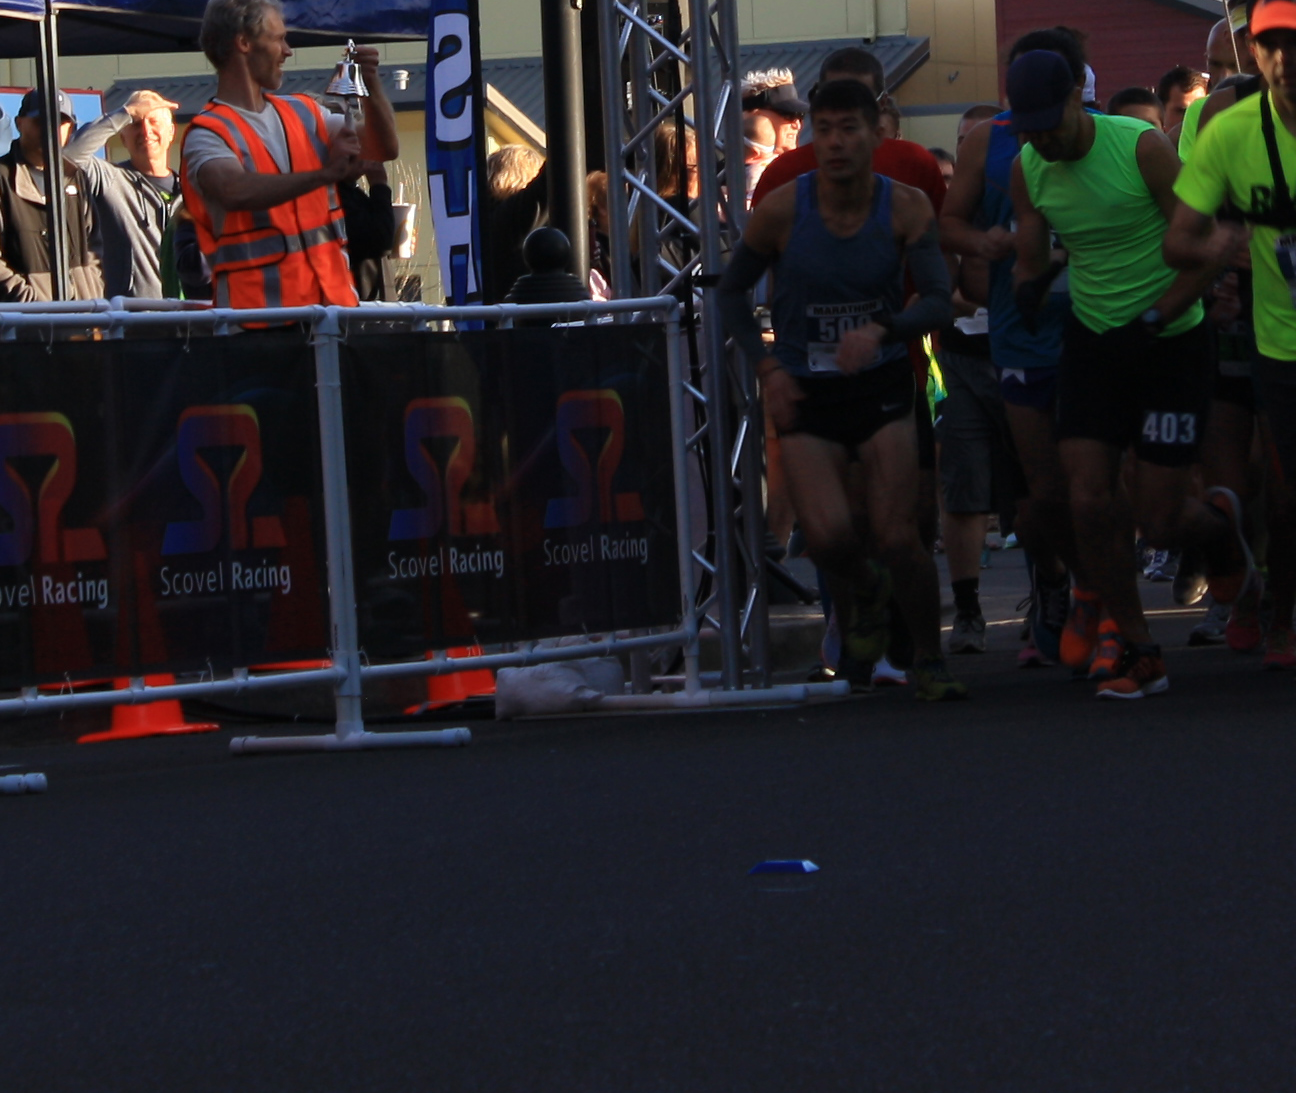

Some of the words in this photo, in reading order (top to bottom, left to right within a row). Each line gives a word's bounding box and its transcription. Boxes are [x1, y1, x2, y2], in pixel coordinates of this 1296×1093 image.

[813, 301, 878, 315] MARATHON
[1142, 410, 1197, 444] 403
[387, 547, 444, 580] Scovel
[449, 544, 504, 579] Racing
[543, 534, 594, 566] Scovel
[600, 531, 648, 565] Racing
[42, 571, 109, 608] Racing
[160, 562, 224, 597] Scovel
[231, 558, 292, 594] Racing
